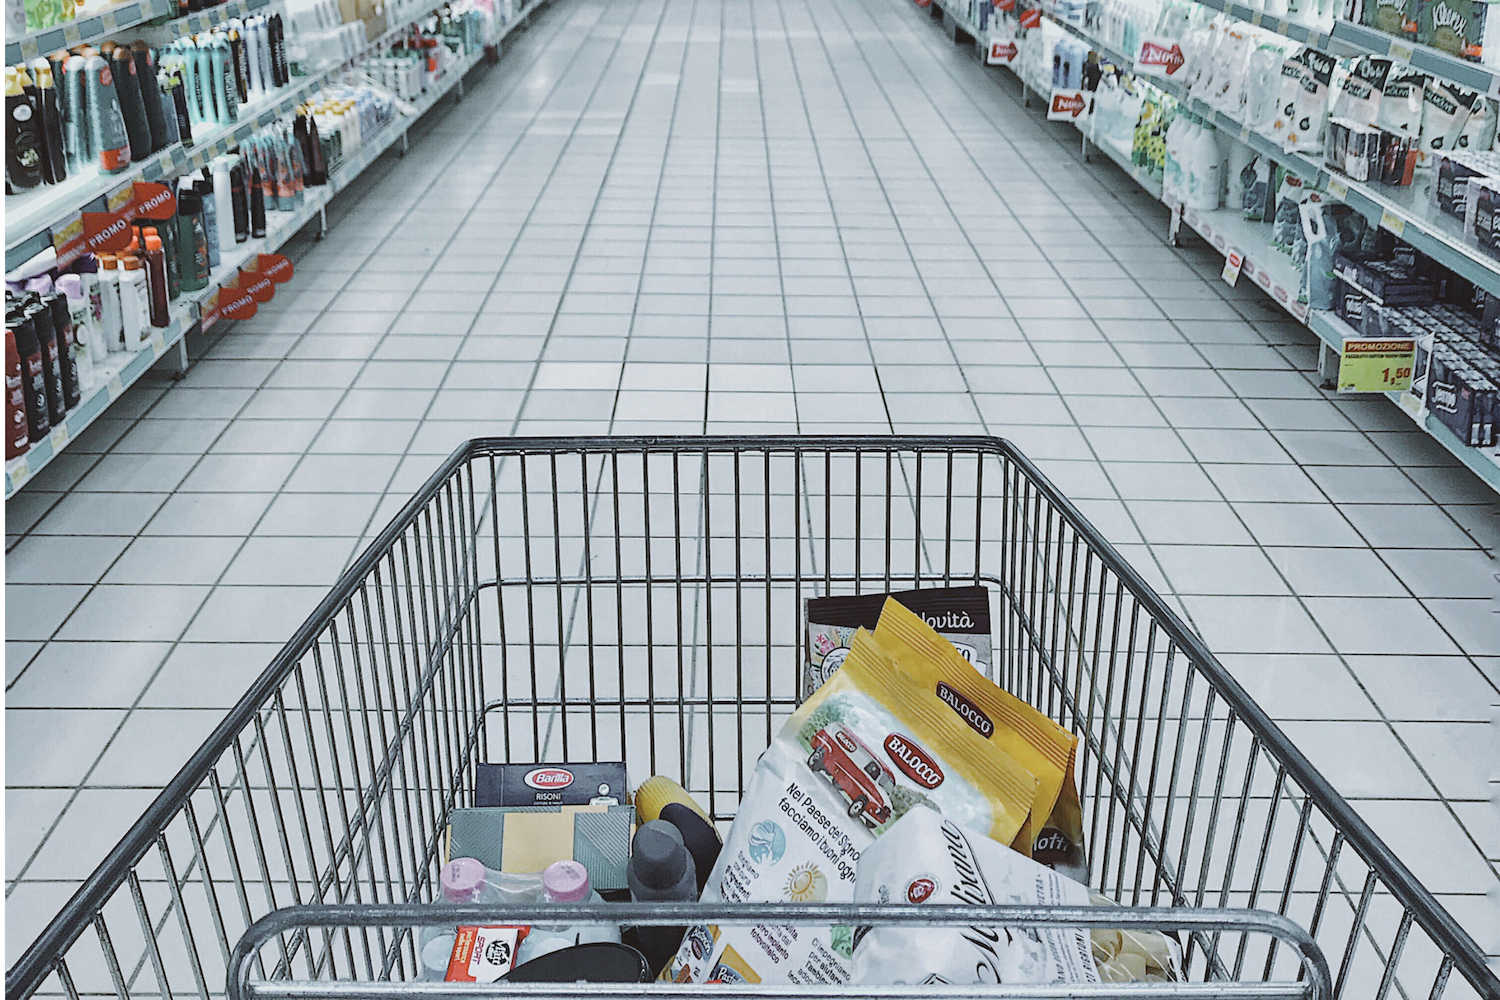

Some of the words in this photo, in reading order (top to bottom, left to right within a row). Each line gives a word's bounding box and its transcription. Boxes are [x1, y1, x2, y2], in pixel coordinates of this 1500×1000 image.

[138, 190, 171, 214] PROMO
[88, 219, 126, 248] PROMO
[247, 278, 271, 295] ROMO
[221, 294, 253, 315] PROMO
[1347, 342, 1410, 351] PROMOZIONE
[939, 686, 992, 734] BALOCCO
[887, 735, 942, 786] BALOCCO
[535, 773, 570, 783] Barilla
[535, 793, 561, 801] RISONI
[786, 782, 805, 802] Nel
[801, 797, 831, 830] Paese
[838, 835, 860, 861] Signo
[778, 797, 820, 842] facciamo
[819, 841, 840, 865] buoni
[837, 861, 857, 883] ogni
[472, 935, 486, 965] SPORT
[750, 928, 779, 964] fotovoltaico
[768, 931, 789, 960] impianto
[818, 944, 851, 981] impegniamo
